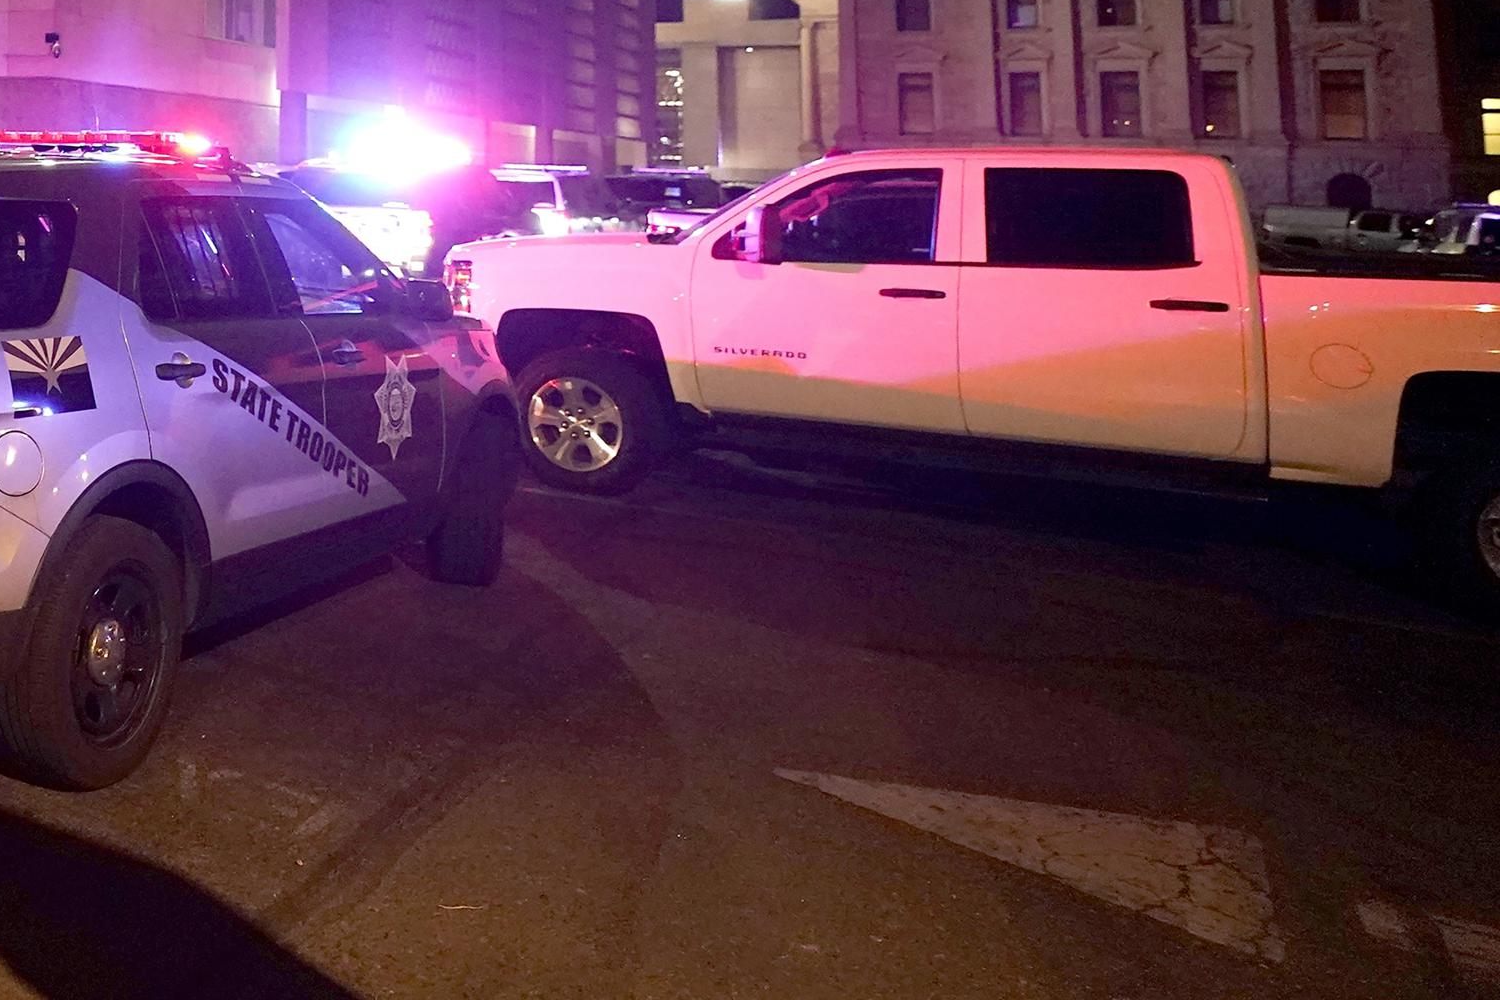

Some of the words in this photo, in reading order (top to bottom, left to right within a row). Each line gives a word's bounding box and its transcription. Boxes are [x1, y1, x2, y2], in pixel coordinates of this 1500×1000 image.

[713, 346, 807, 359] SILVERADO
[212, 358, 284, 433] STATE
[285, 409, 370, 497] TROOPER
